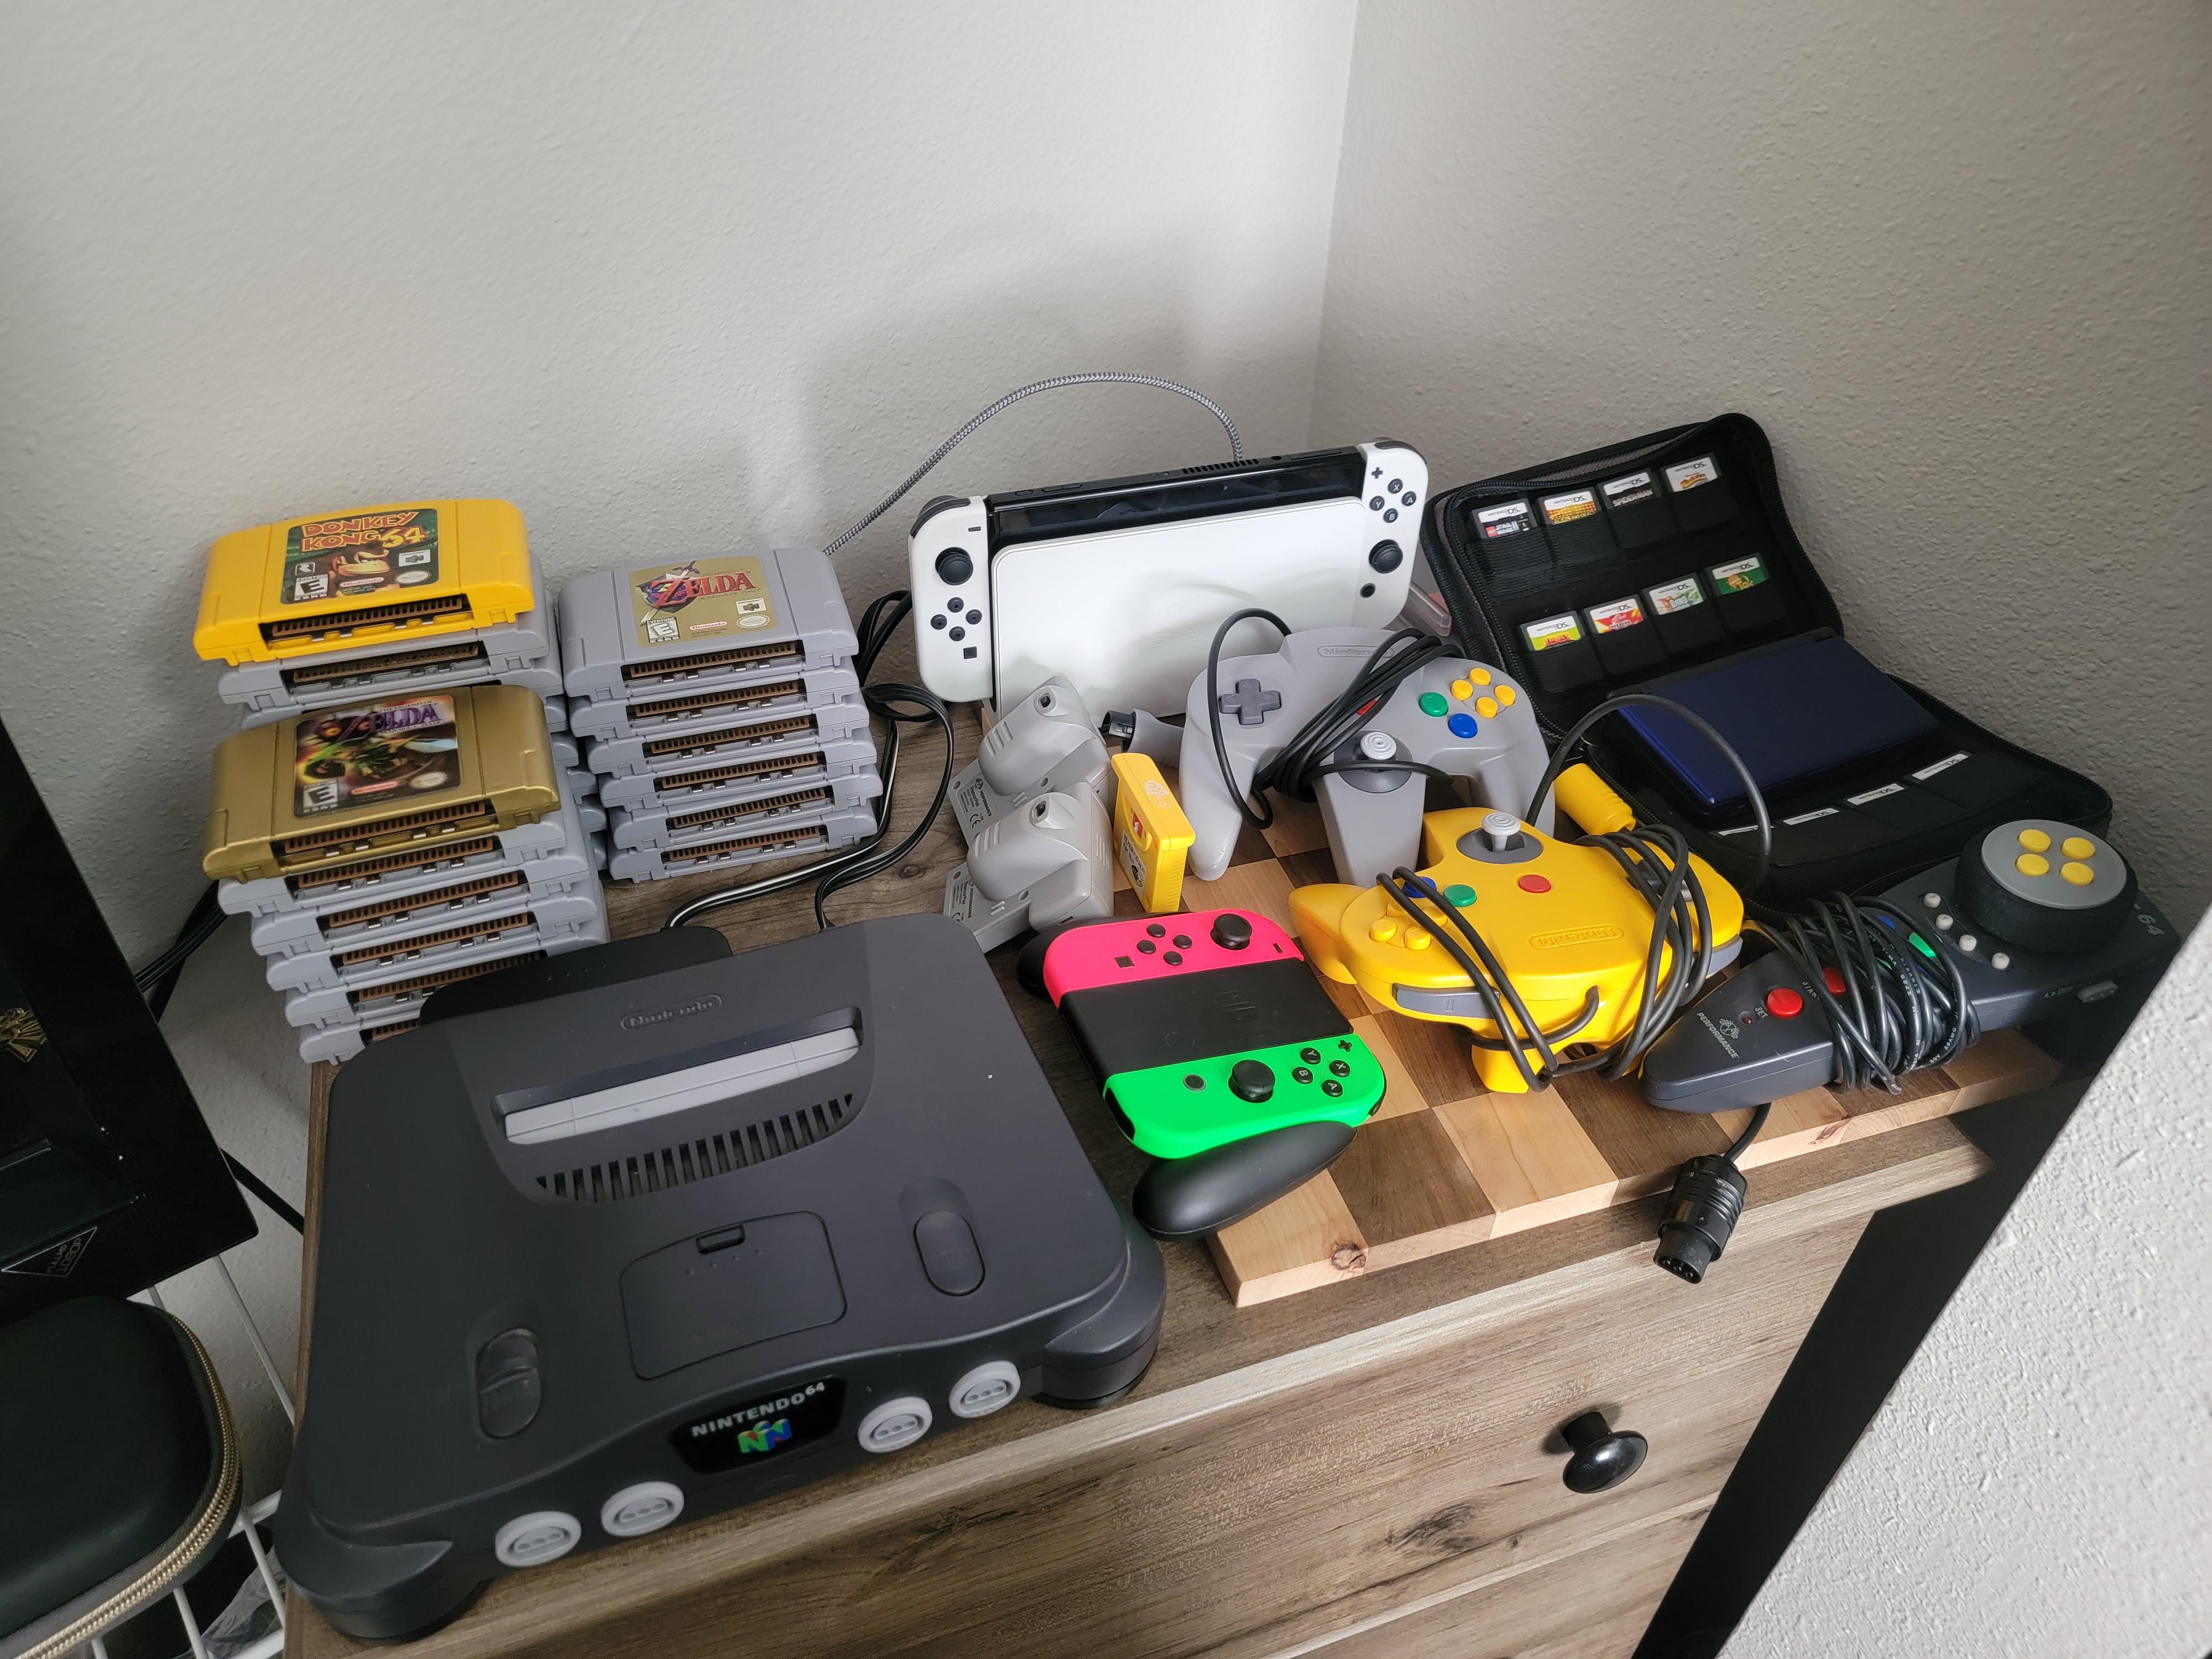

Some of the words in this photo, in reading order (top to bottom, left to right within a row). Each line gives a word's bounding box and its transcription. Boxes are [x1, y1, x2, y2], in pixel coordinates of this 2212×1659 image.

[301, 512, 420, 537] DONKEY
[301, 530, 383, 552] KONG
[381, 525, 428, 549] 64
[300, 580, 325, 594] E
[650, 572, 757, 607] ZELDA
[653, 623, 674, 637] E
[1324, 648, 1383, 656] Ninten
[309, 786, 335, 804] E
[1755, 1007, 1768, 1018] SET
[1697, 1012, 1739, 1058] PERFORMANCE
[1929, 1053, 1940, 1064] 30V
[57, 1238, 82, 1272] 1080P
[692, 1392, 805, 1437] NINTENDO
[805, 1382, 825, 1396] 64
